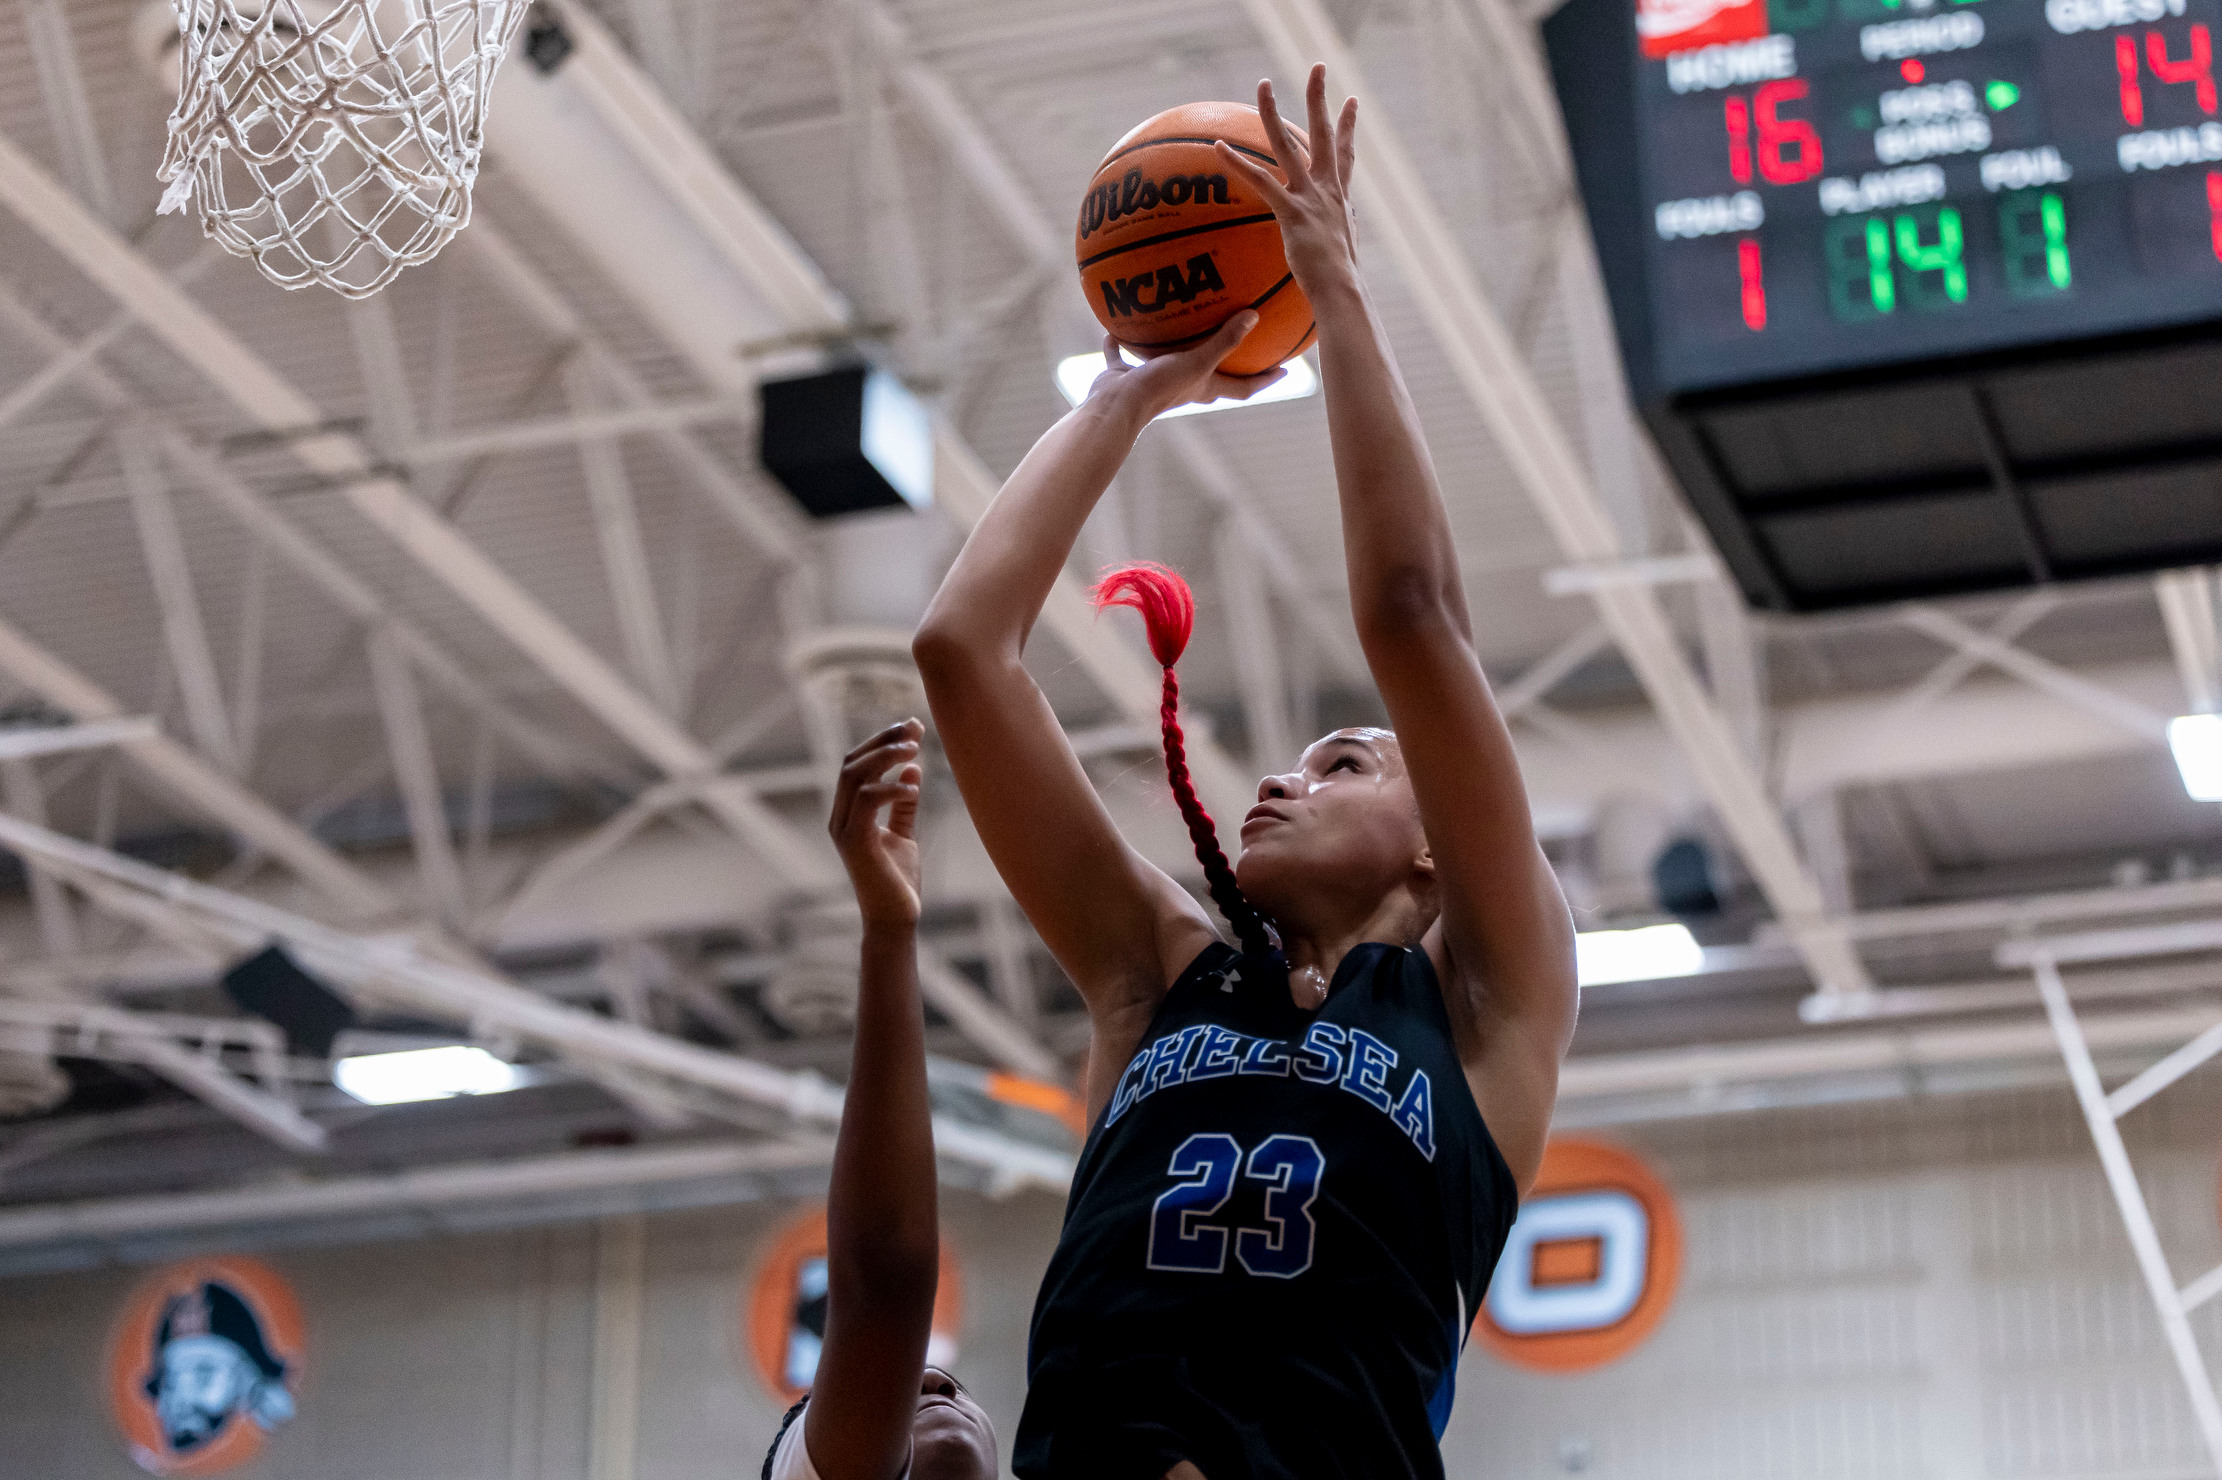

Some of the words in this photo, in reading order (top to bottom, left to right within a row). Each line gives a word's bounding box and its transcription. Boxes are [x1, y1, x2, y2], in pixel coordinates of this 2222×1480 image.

[1667, 34, 1796, 94] HOME
[1860, 11, 1985, 60] PERIOD
[2115, 25, 2218, 126] 14
[1726, 79, 1824, 185] 16
[1874, 114, 1992, 164] BONUS
[2118, 121, 2222, 172] FOULS
[1819, 164, 1945, 215] PLAYER
[1980, 146, 2071, 190] FOUL
[1081, 167, 1231, 240] Wilson
[1655, 191, 1764, 239] FOULS
[1865, 209, 1968, 313] 14
[2042, 195, 2072, 290] 1
[1101, 251, 1227, 318] NCAA
[1738, 240, 1767, 331] 1
[1105, 1020, 1437, 1163] CHELSEA
[1146, 1133, 1327, 1280] 23
